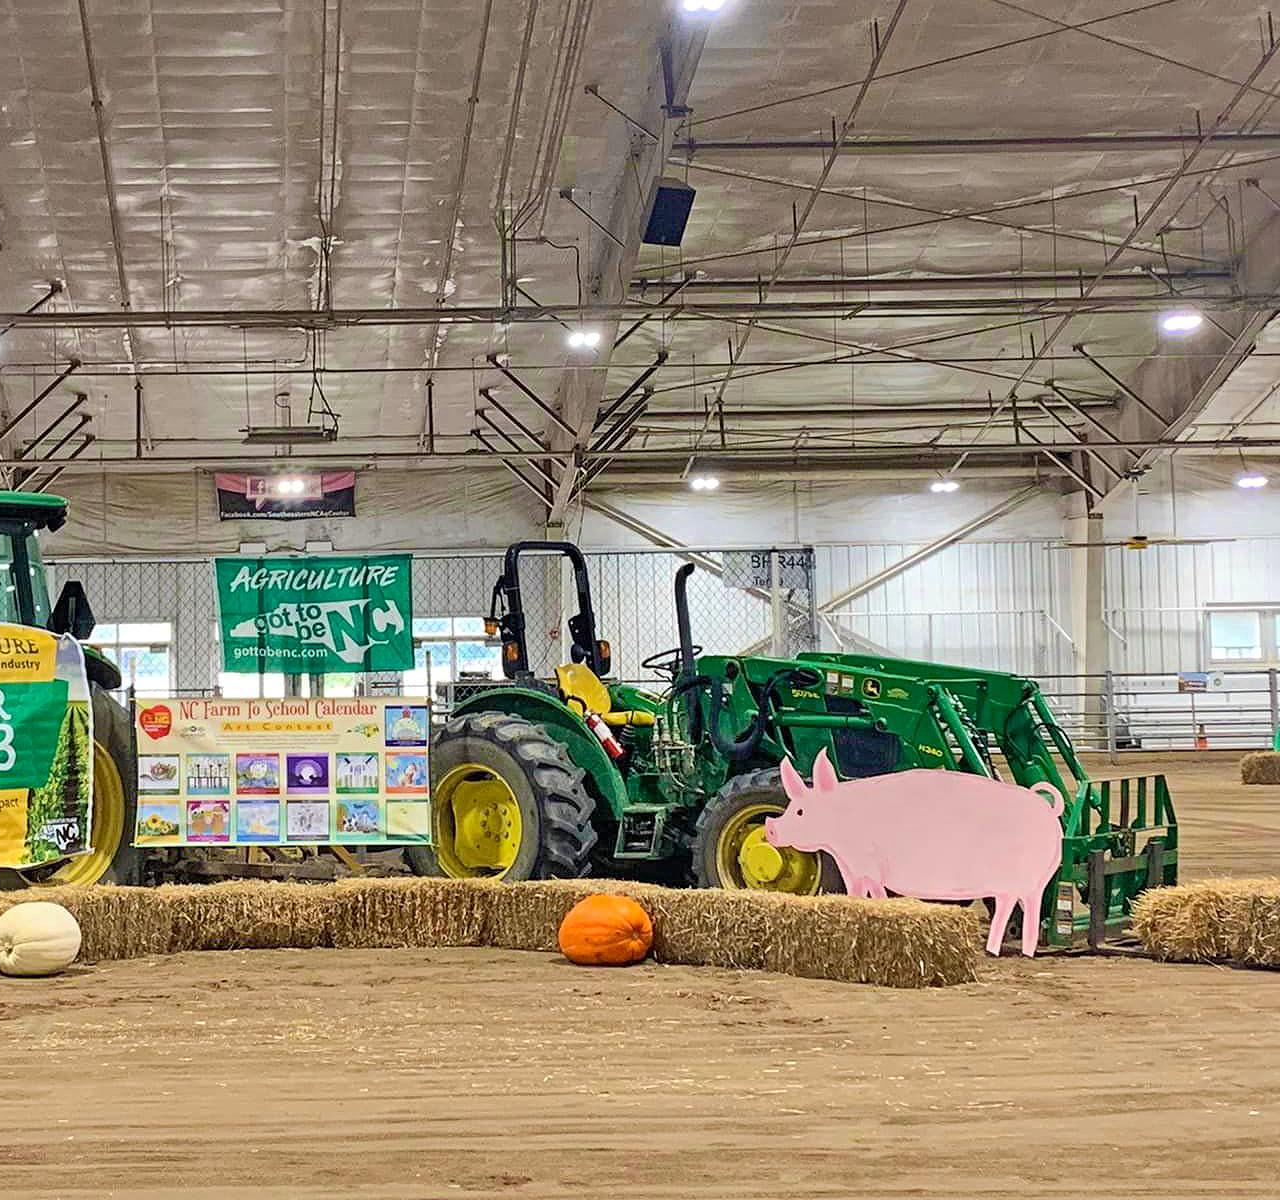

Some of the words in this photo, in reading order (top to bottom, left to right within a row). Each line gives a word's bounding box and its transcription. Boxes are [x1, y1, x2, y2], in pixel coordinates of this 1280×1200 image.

[230, 565, 399, 593] AGRICULTURE
[254, 606, 294, 635] got
[296, 603, 322, 622] to
[327, 600, 396, 651] NC
[296, 621, 326, 641] be
[233, 645, 328, 659] gottobenc.com
[180, 701, 199, 720] NC
[203, 700, 240, 720] Farm
[245, 700, 260, 719] To
[265, 700, 309, 719] School
[315, 700, 377, 719] Calendar
[56, 822, 76, 845] NC
